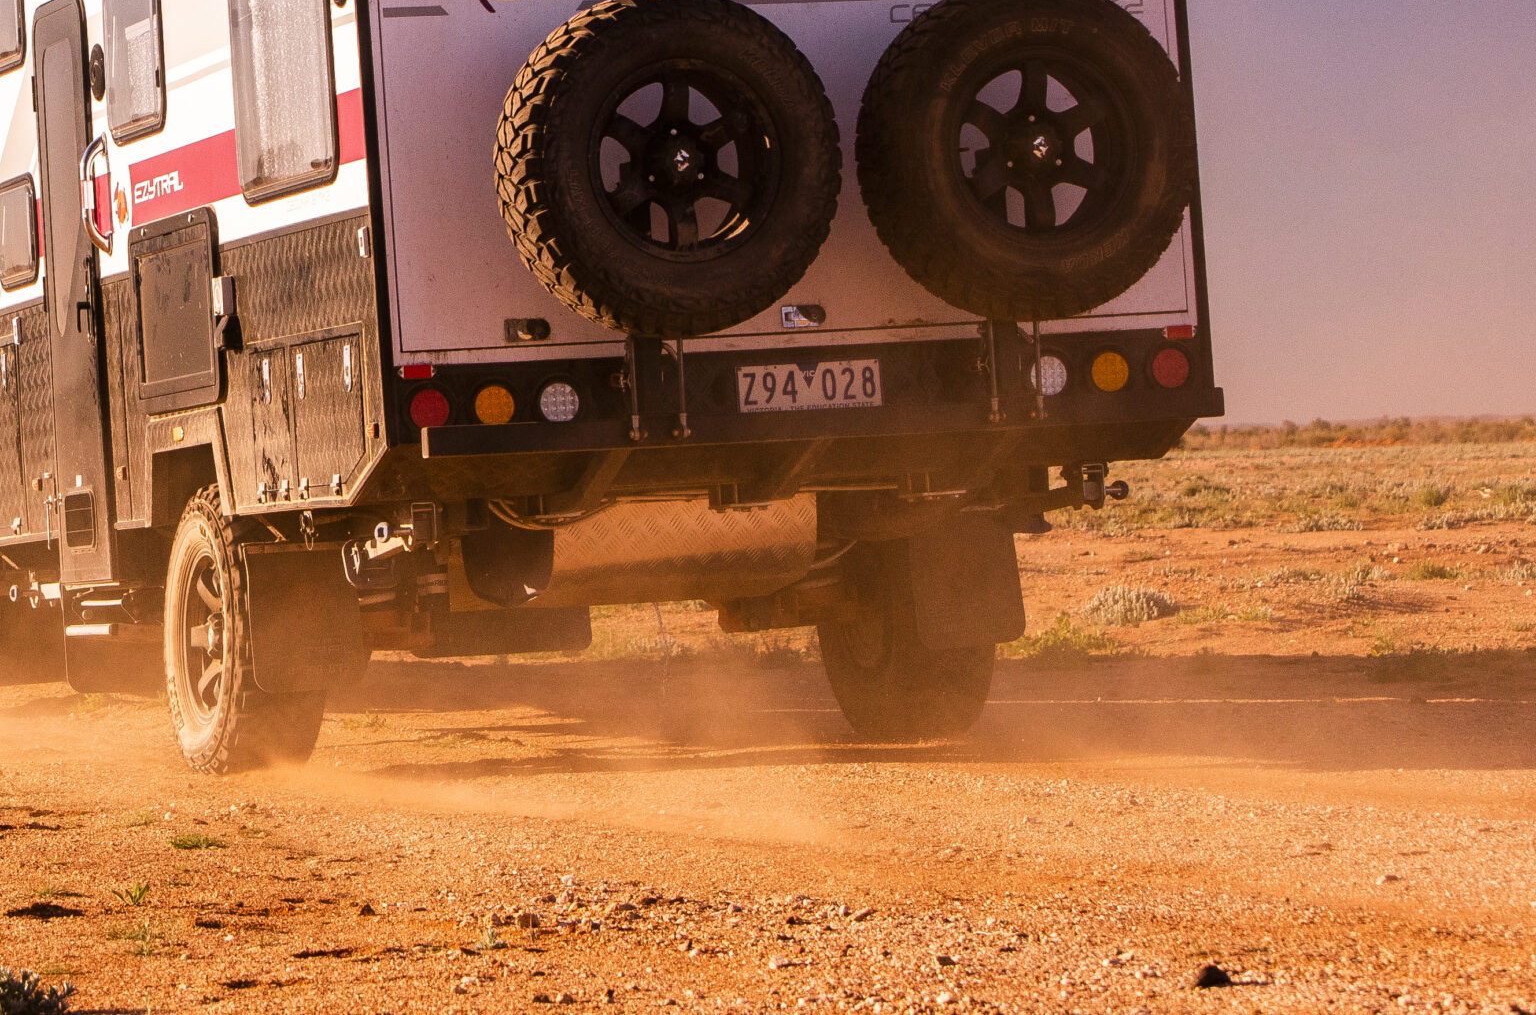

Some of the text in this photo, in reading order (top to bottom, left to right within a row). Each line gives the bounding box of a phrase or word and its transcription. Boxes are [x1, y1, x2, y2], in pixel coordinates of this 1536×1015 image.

[939, 19, 1023, 91] KLEVER
[133, 170, 184, 204] EZYTRAIL
[742, 366, 876, 406] Z94 028
[800, 370, 816, 378] VIC
